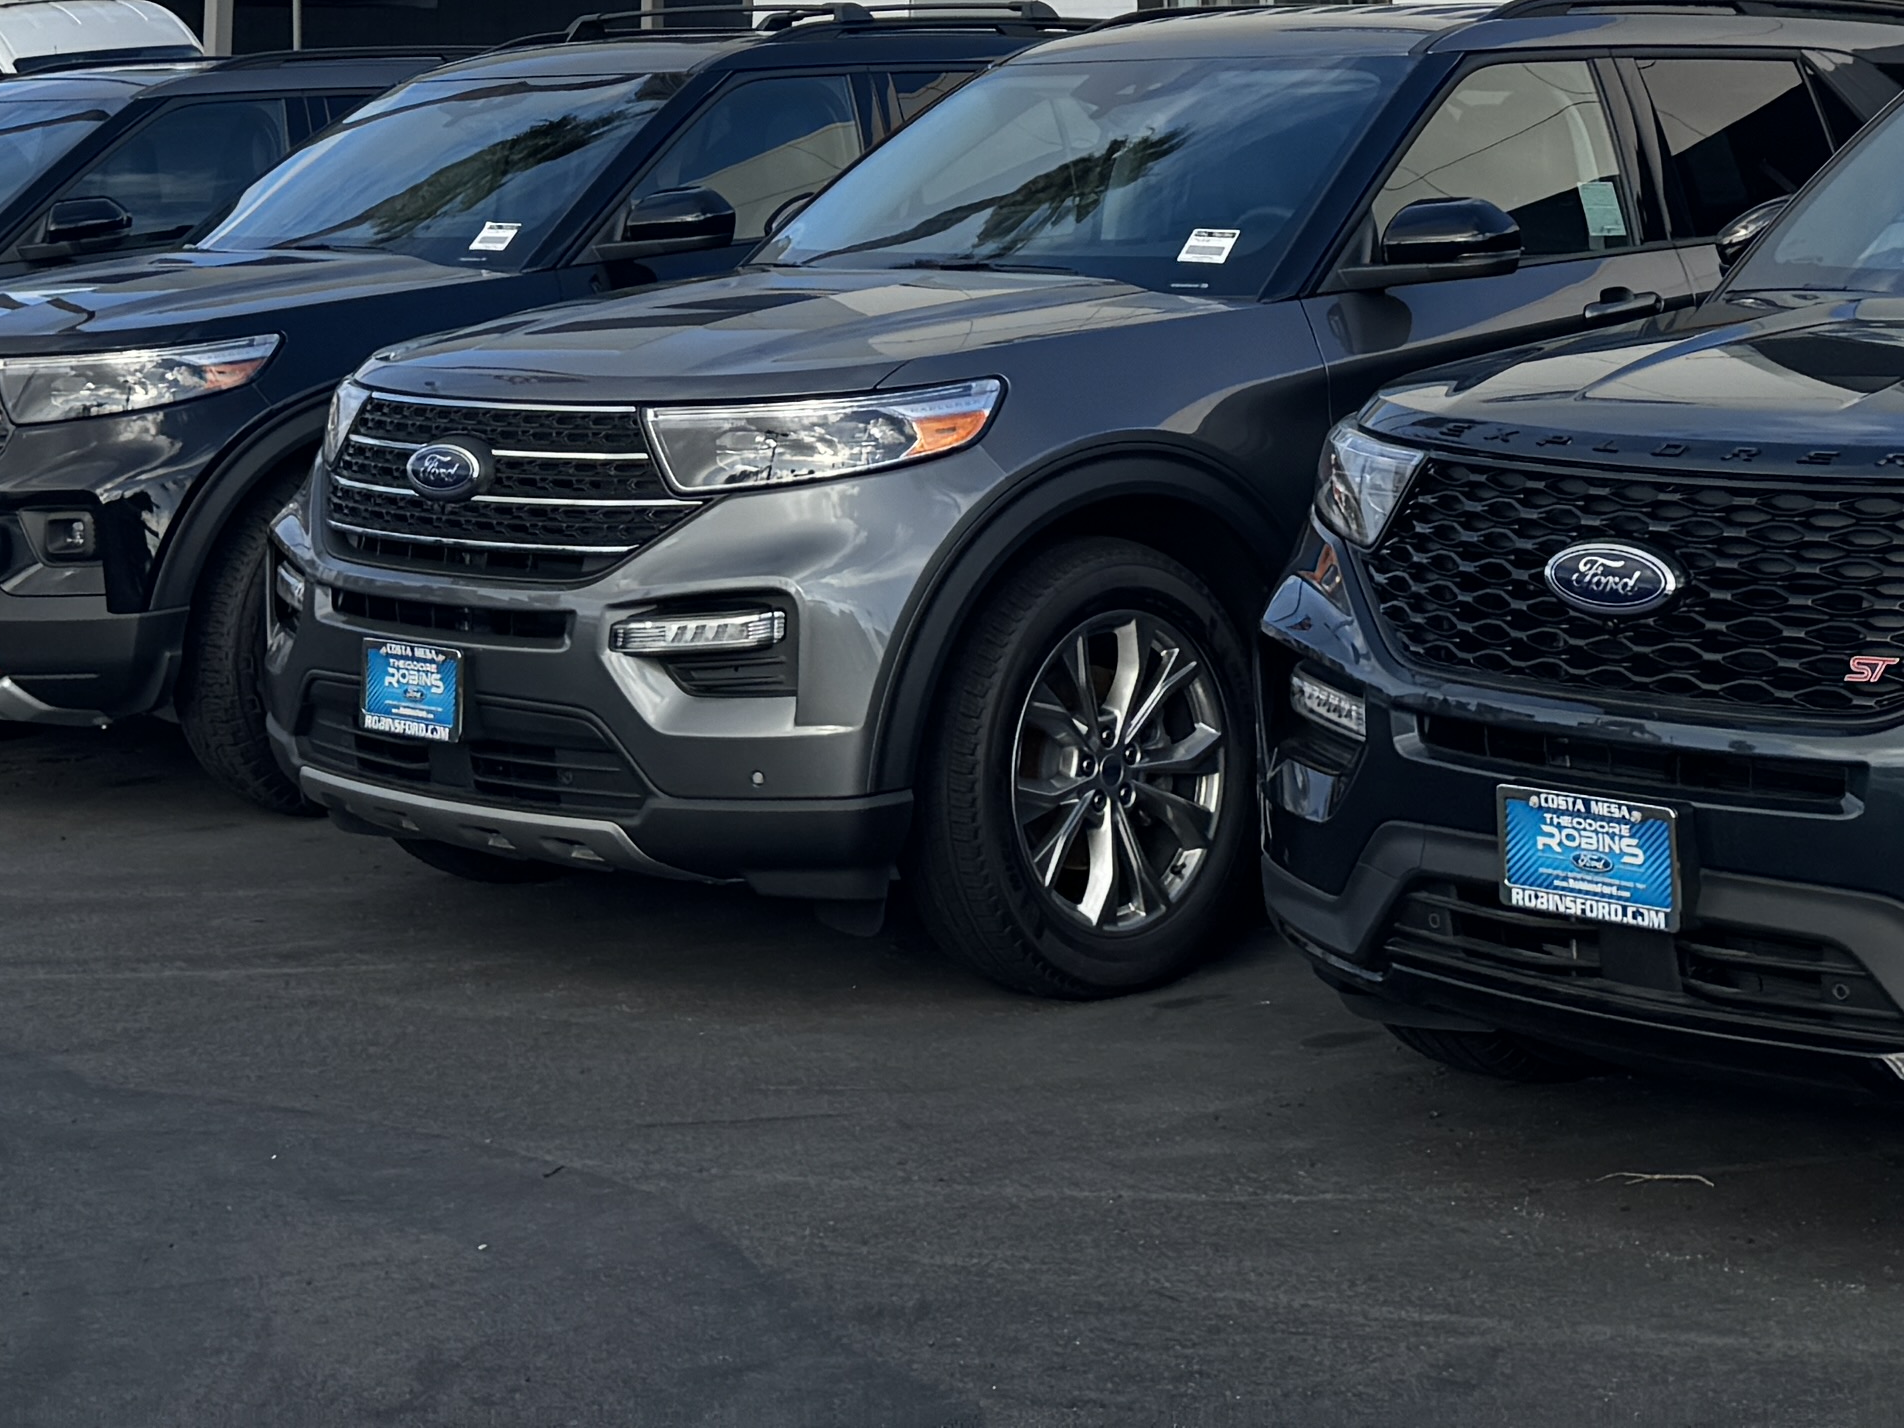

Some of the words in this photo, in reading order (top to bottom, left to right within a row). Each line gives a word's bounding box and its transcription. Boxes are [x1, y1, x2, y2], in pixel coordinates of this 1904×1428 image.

[420, 453, 460, 482] Ford
[1571, 556, 1642, 596] Ford
[386, 643, 412, 657] COSTA
[389, 658, 437, 672] THEODORE
[1844, 655, 1900, 682] ST
[384, 667, 444, 694] ROBINS
[1540, 794, 1586, 814] COSTA
[1590, 800, 1630, 820] MESA
[1543, 813, 1631, 837] THEODORE
[1536, 824, 1645, 865] ROBINS
[1577, 853, 1604, 870] Ford
[1511, 888, 1666, 929] ROBINSFORD.COM
